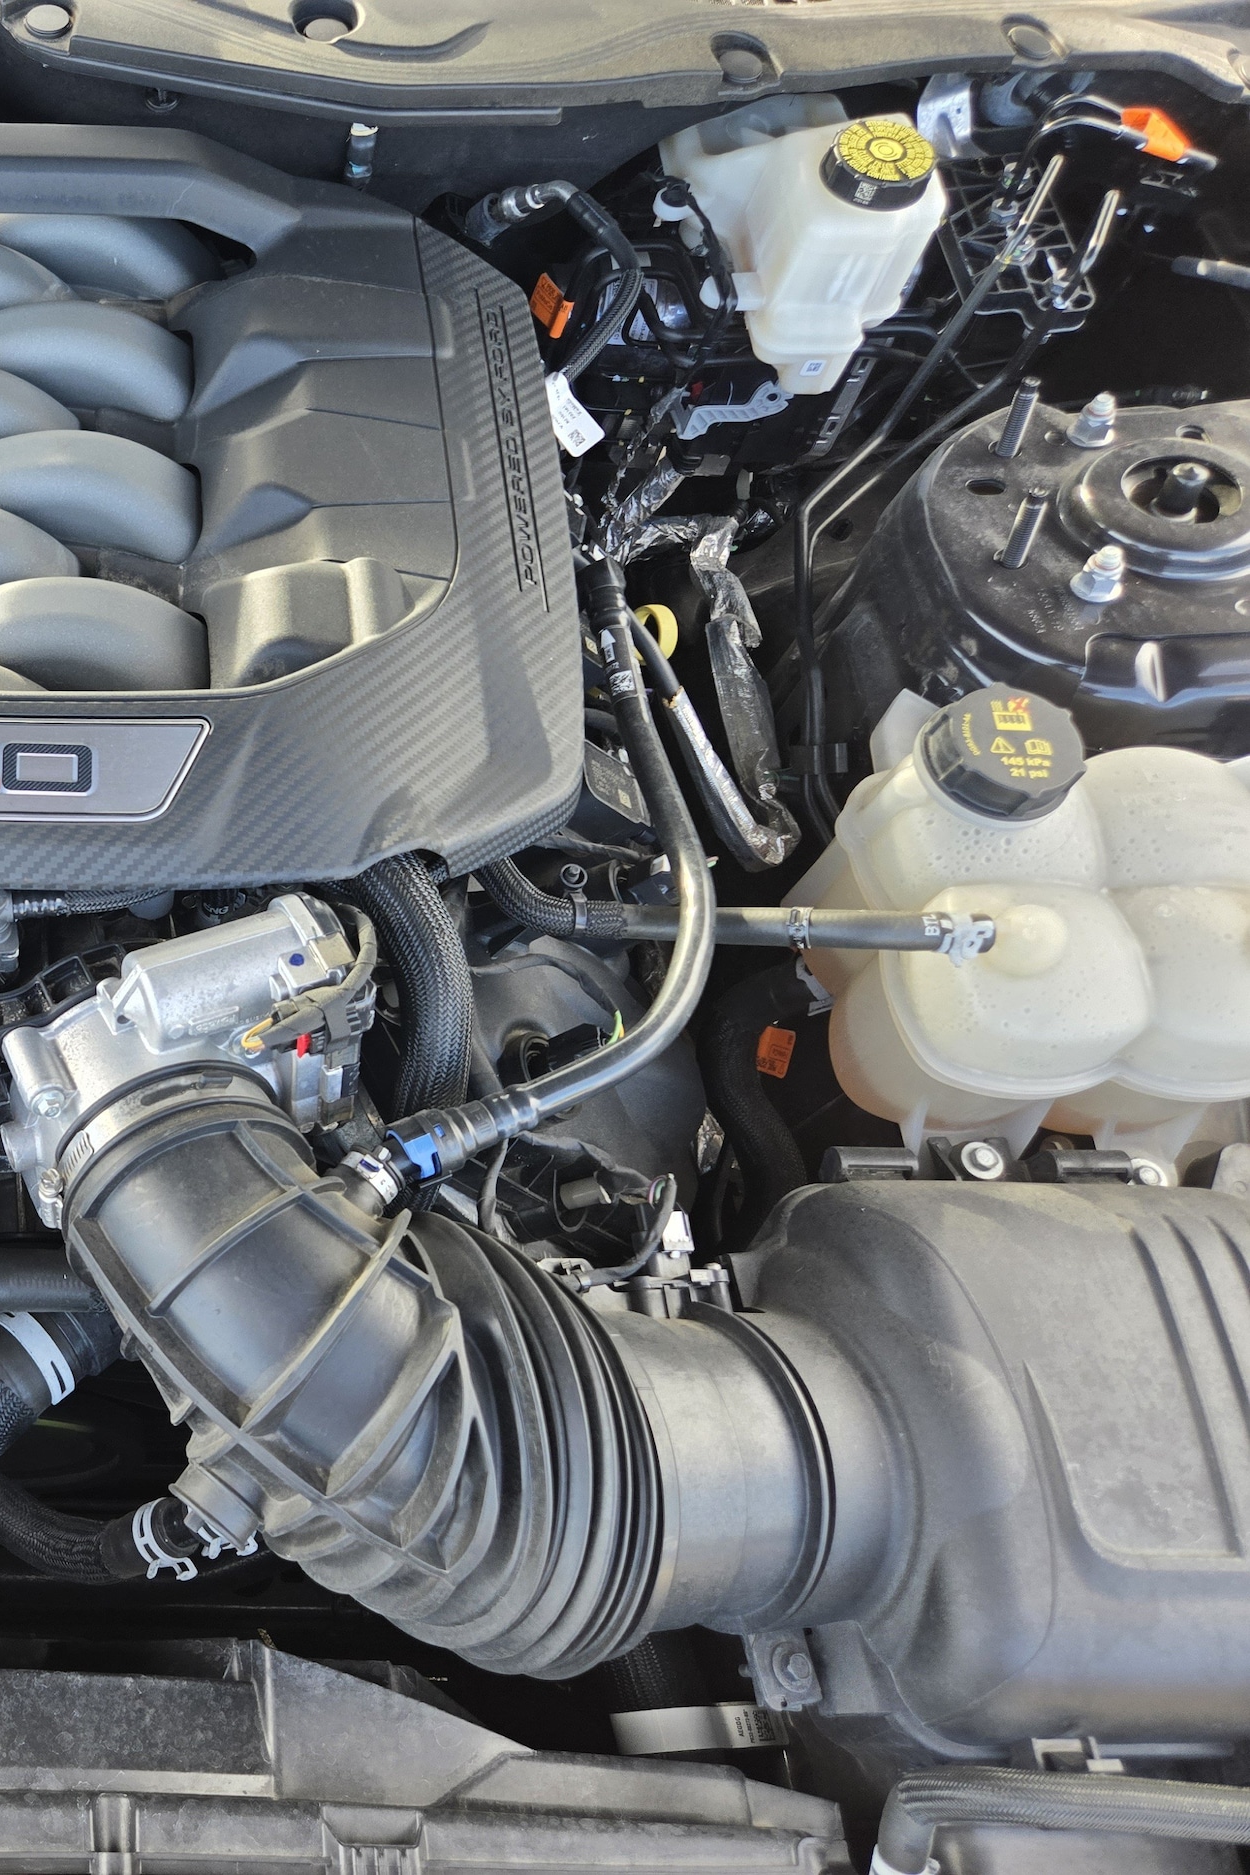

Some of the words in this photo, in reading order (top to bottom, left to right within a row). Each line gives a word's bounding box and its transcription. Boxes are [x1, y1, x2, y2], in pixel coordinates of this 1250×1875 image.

[485, 308, 509, 382] FORD
[496, 384, 515, 427] BY
[505, 436, 538, 587] POWERED
[1000, 756, 1025, 766] 145
[1025, 756, 1051, 767] kPa
[1010, 767, 1026, 777] 21
